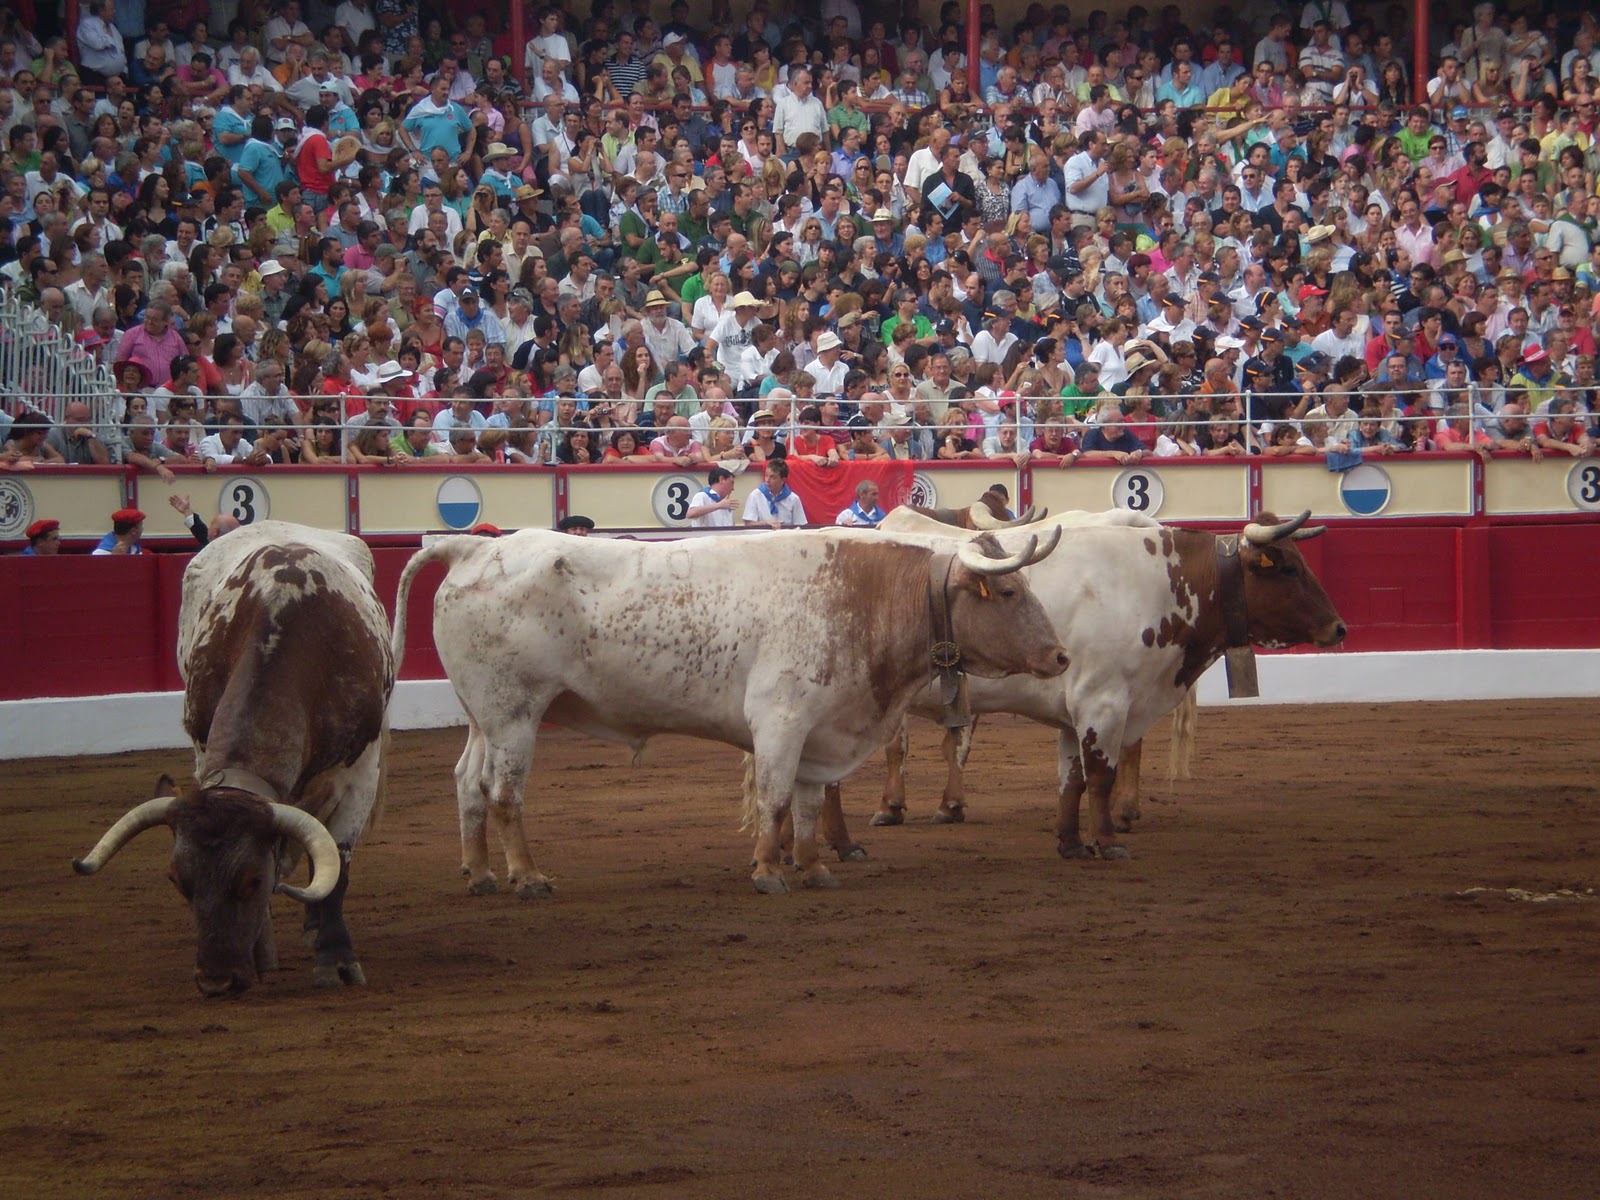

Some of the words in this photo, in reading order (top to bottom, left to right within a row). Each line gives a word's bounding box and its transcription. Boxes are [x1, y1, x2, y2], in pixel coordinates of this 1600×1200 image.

[667, 482, 690, 520] 3
[1127, 474, 1150, 511] 3
[1580, 466, 1600, 503] 3
[232, 485, 255, 526] 3
